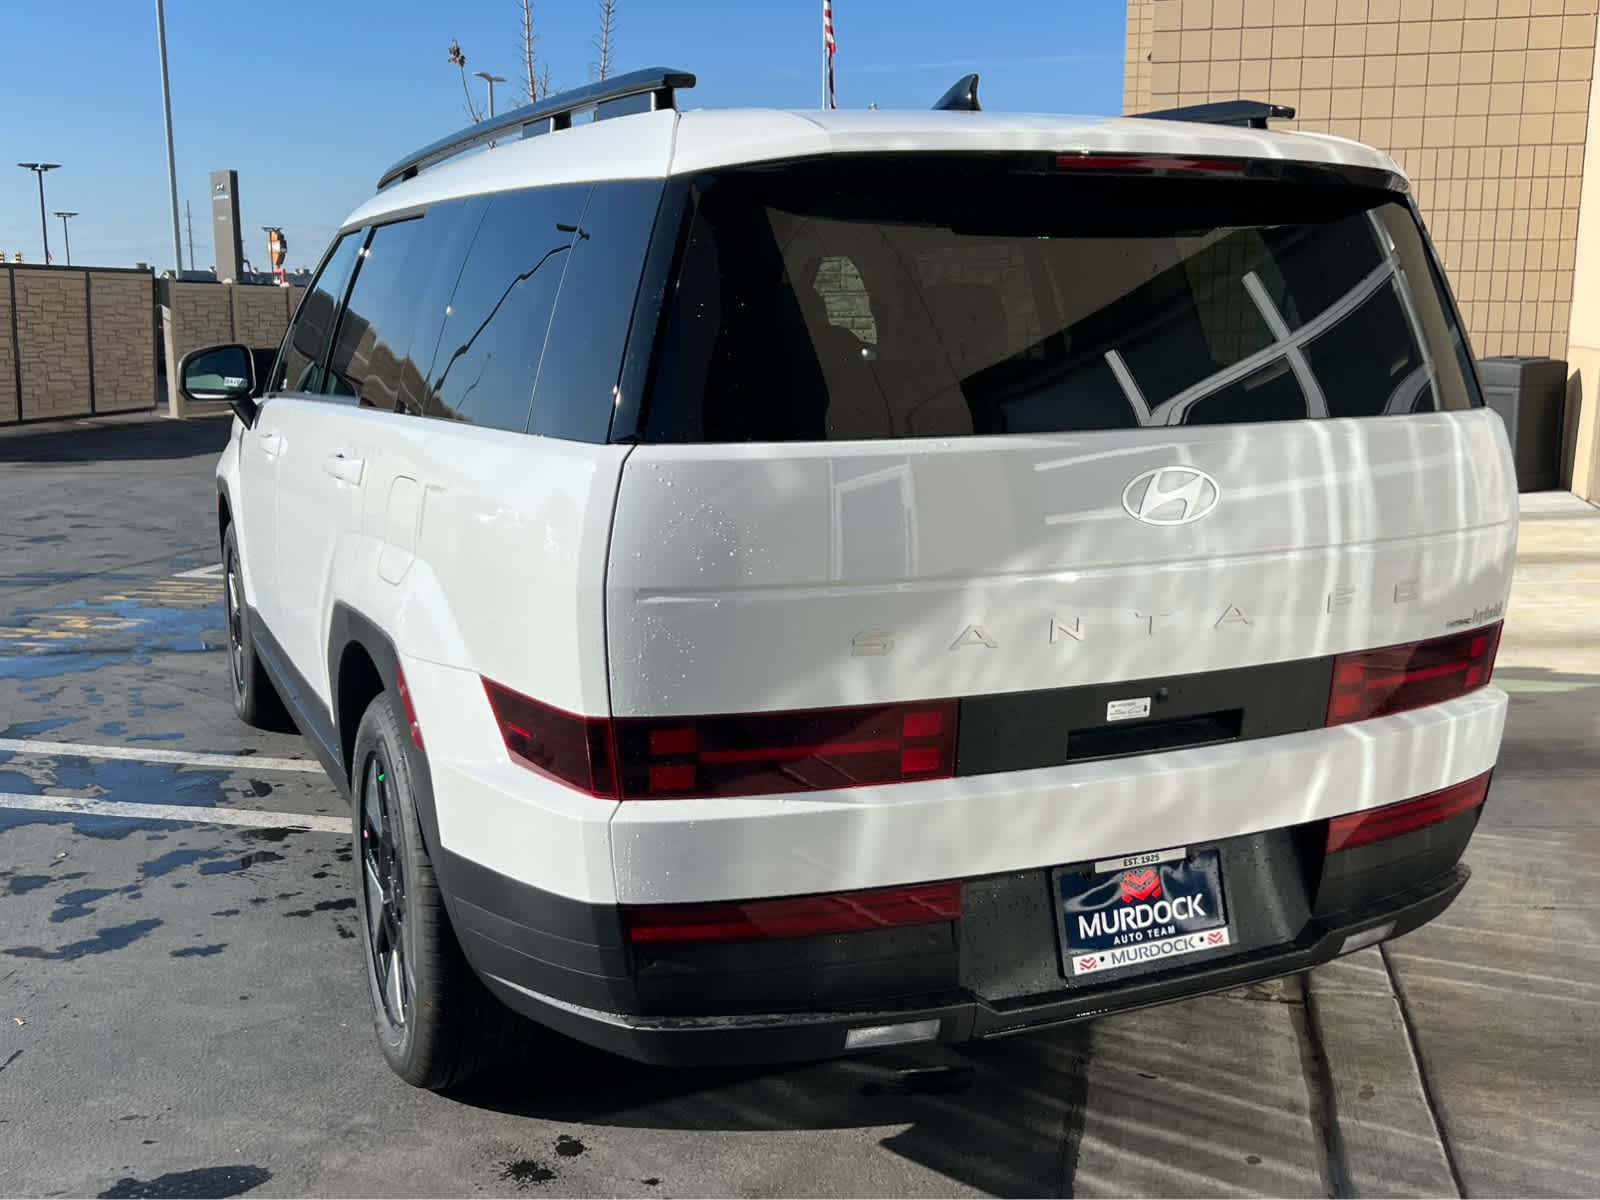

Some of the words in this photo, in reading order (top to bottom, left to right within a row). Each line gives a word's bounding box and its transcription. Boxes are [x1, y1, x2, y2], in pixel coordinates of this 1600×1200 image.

[851, 603, 1253, 657] SANTA
[1123, 857, 1140, 867] EST.
[1141, 854, 1160, 864] 1925
[1078, 893, 1206, 939] MURDOCK
[1113, 932, 1143, 945] AUTO
[1147, 925, 1176, 939] TEAM
[1111, 937, 1196, 965] MURDOCK
